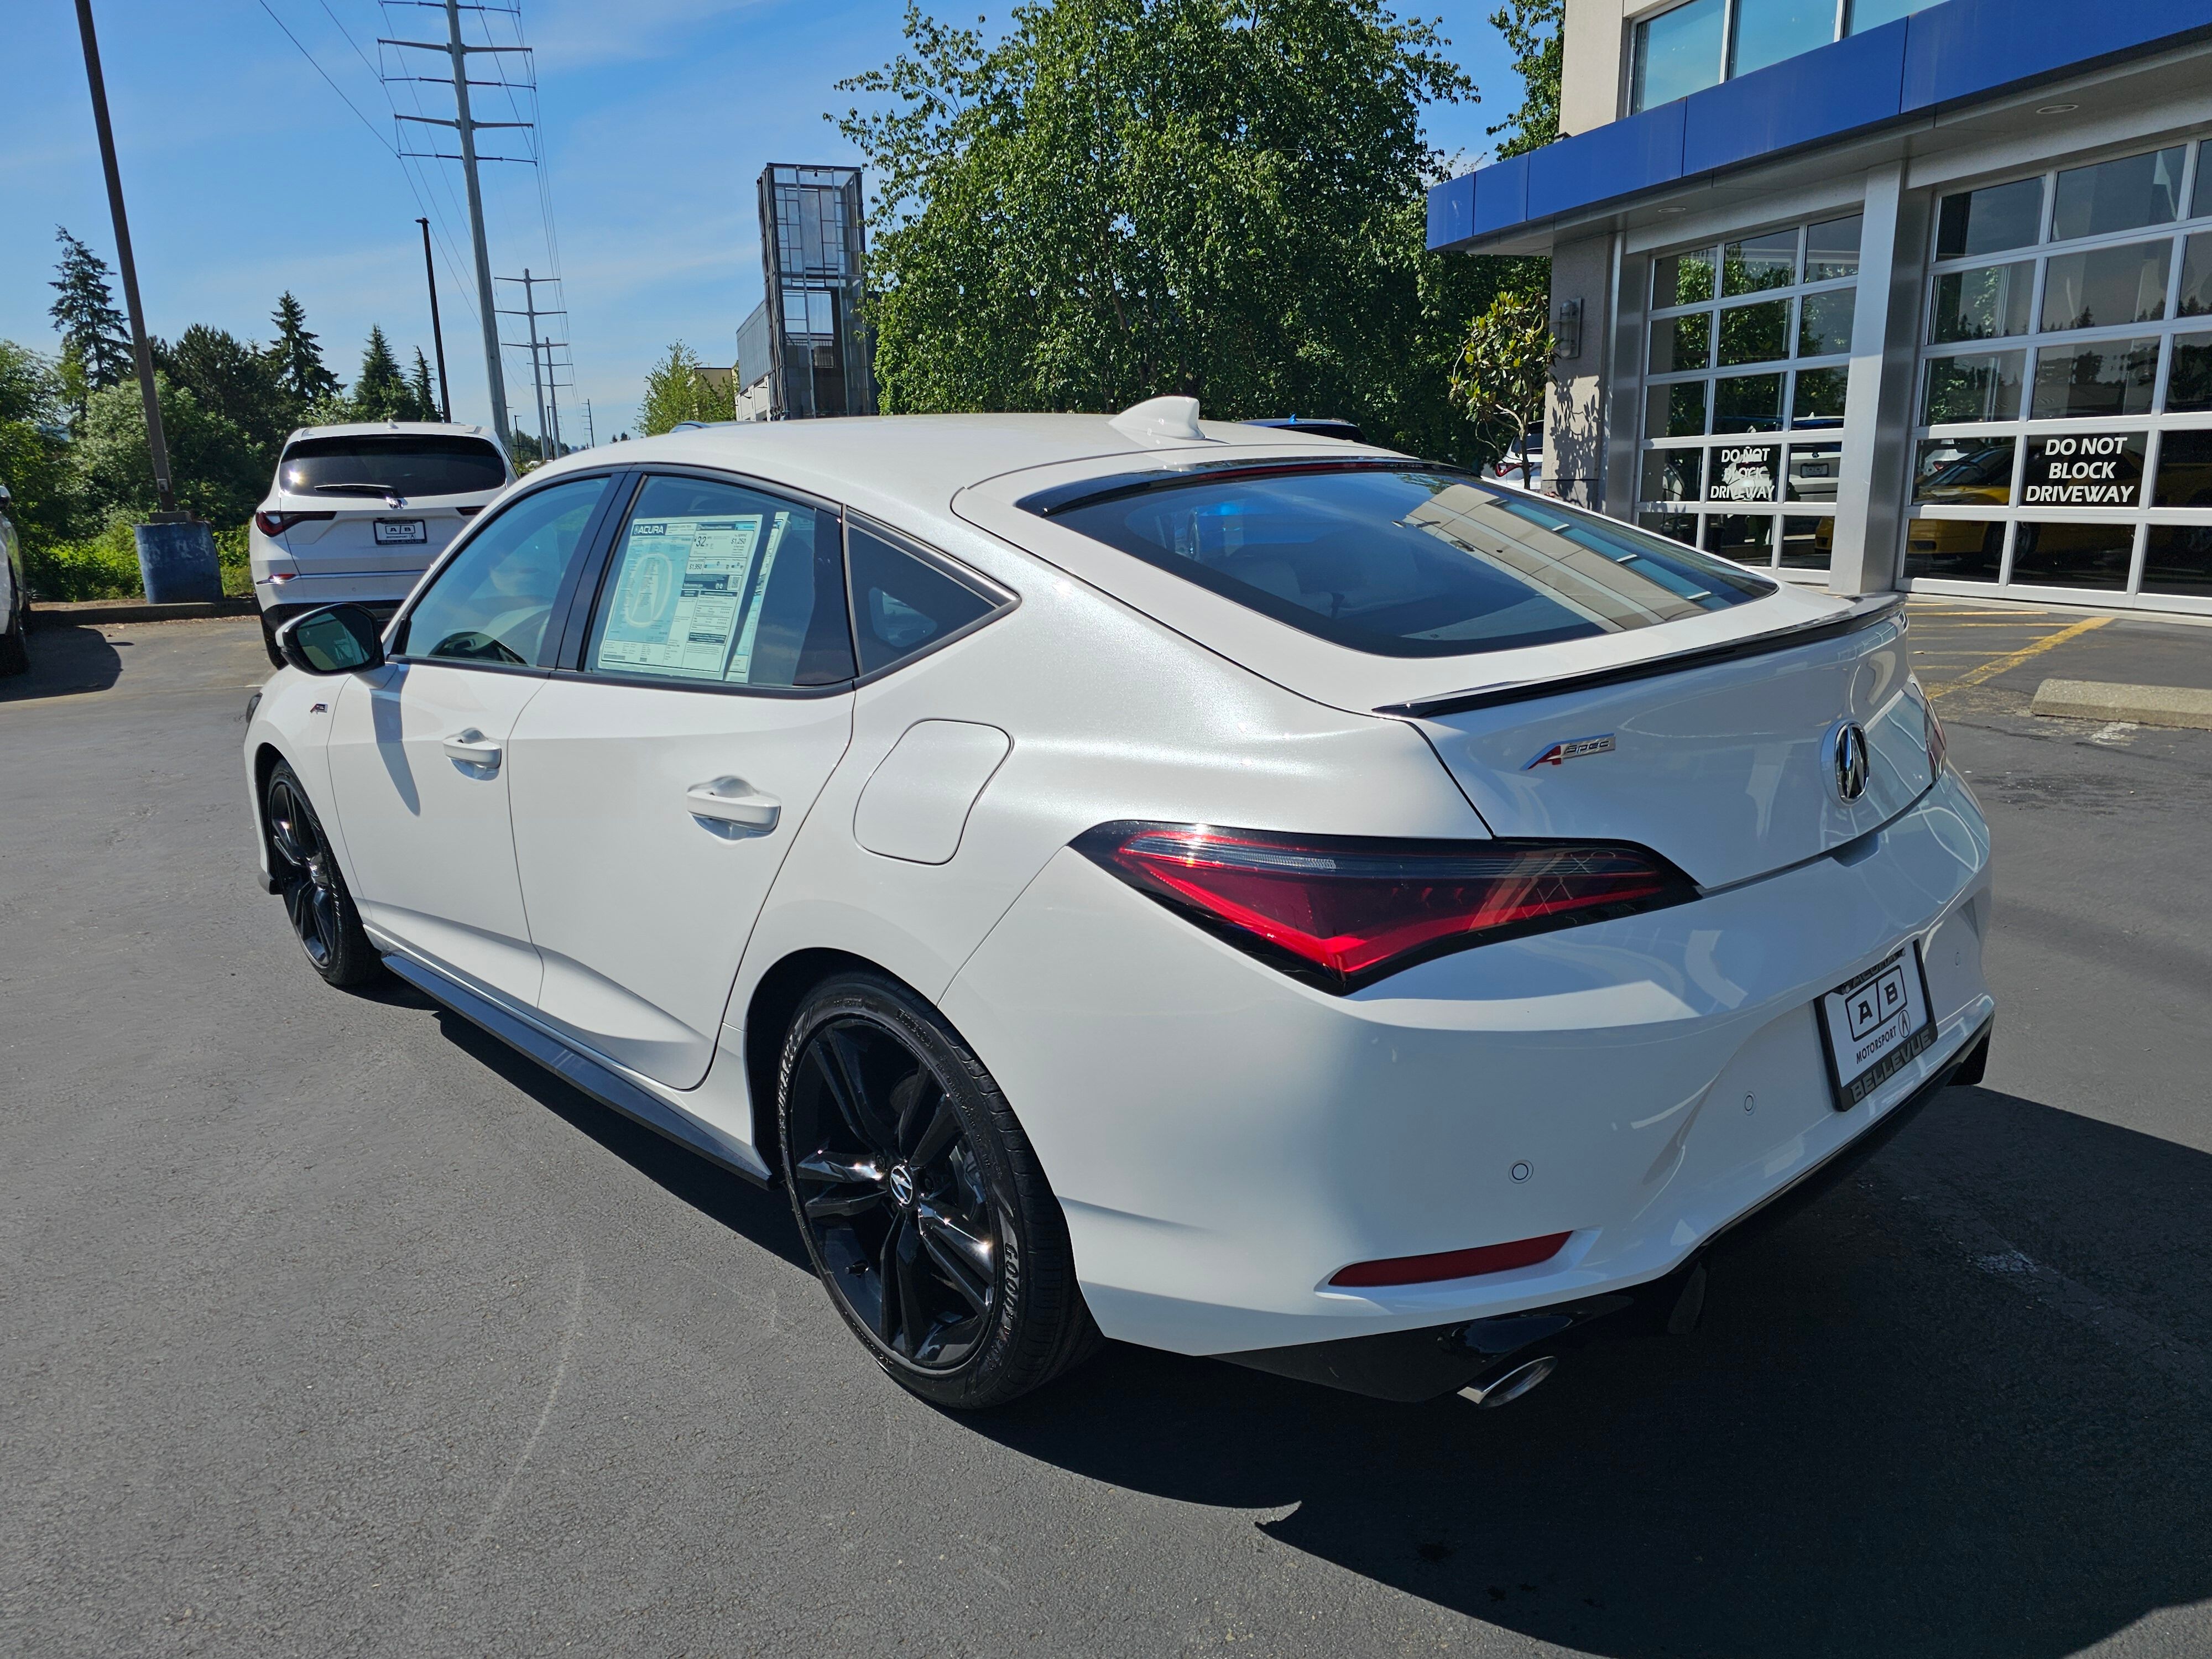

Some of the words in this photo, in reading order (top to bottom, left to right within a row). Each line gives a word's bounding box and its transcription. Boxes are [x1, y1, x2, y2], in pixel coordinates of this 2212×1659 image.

[1721, 448, 1741, 462] DO
[1742, 448, 1770, 462] NOT
[2045, 438, 2077, 456] DO
[2080, 437, 2128, 455] NOT
[2048, 462, 2117, 479] BLOCK
[1710, 485, 1776, 499] DRIVEWAY
[2026, 486, 2135, 503] DRIVEWAY
[638, 525, 664, 534] ACURA
[696, 536, 707, 547] 32
[1853, 954, 1897, 987] ACURA
[1858, 1000, 1873, 1025] A
[1884, 981, 1898, 1006] B
[1856, 1025, 1897, 1065] MOTORSPORT
[1850, 1029, 1932, 1103] BELLEVUE
